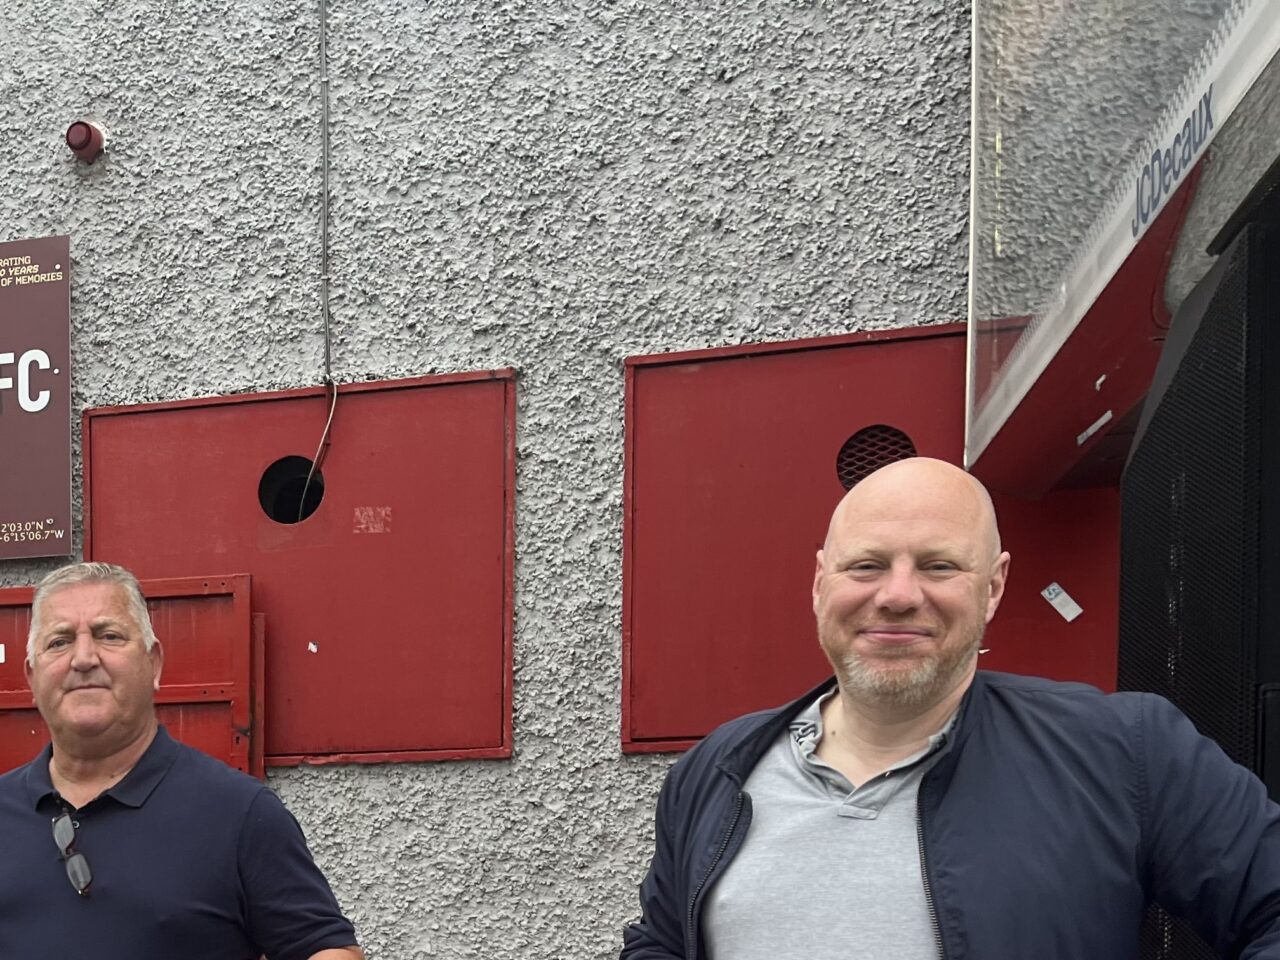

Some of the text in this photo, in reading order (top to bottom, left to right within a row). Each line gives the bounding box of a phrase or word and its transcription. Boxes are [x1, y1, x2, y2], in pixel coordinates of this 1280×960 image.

[1131, 82, 1215, 238] JCDecaux
[8, 264, 39, 276] YEARS
[0, 271, 63, 287] OF MEMORIES
